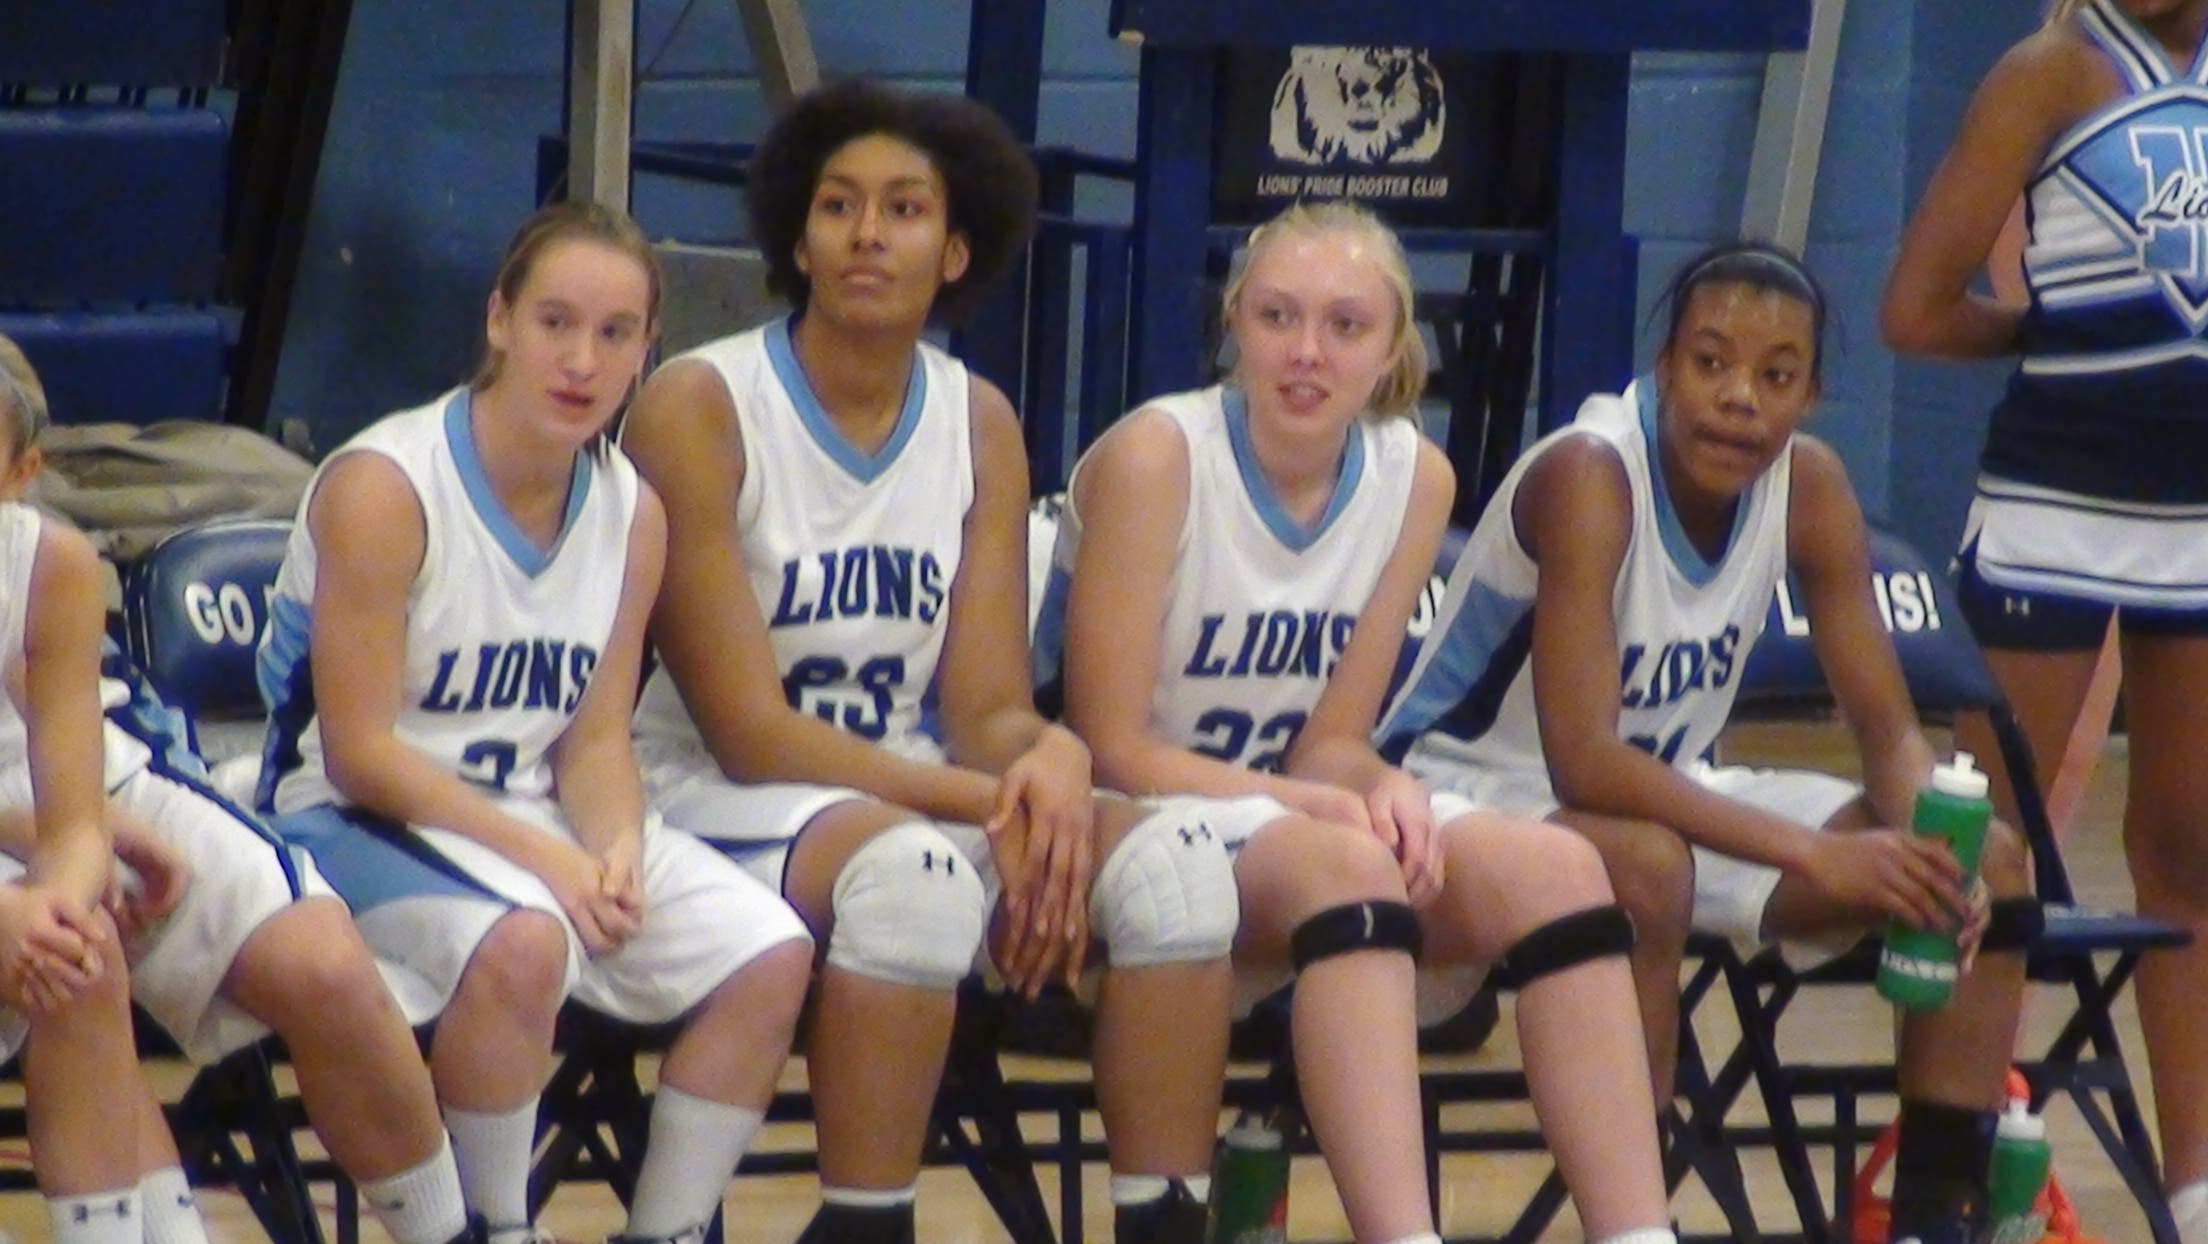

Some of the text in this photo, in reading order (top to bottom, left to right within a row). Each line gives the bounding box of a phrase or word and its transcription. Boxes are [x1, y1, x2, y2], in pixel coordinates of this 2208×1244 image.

[1303, 175, 1345, 196] PRIDE
[1346, 175, 1409, 198] BOOSTER
[1411, 175, 1449, 198] CLUB
[184, 580, 255, 646] GO
[769, 545, 944, 629] LIONS
[419, 637, 597, 715] LIONS
